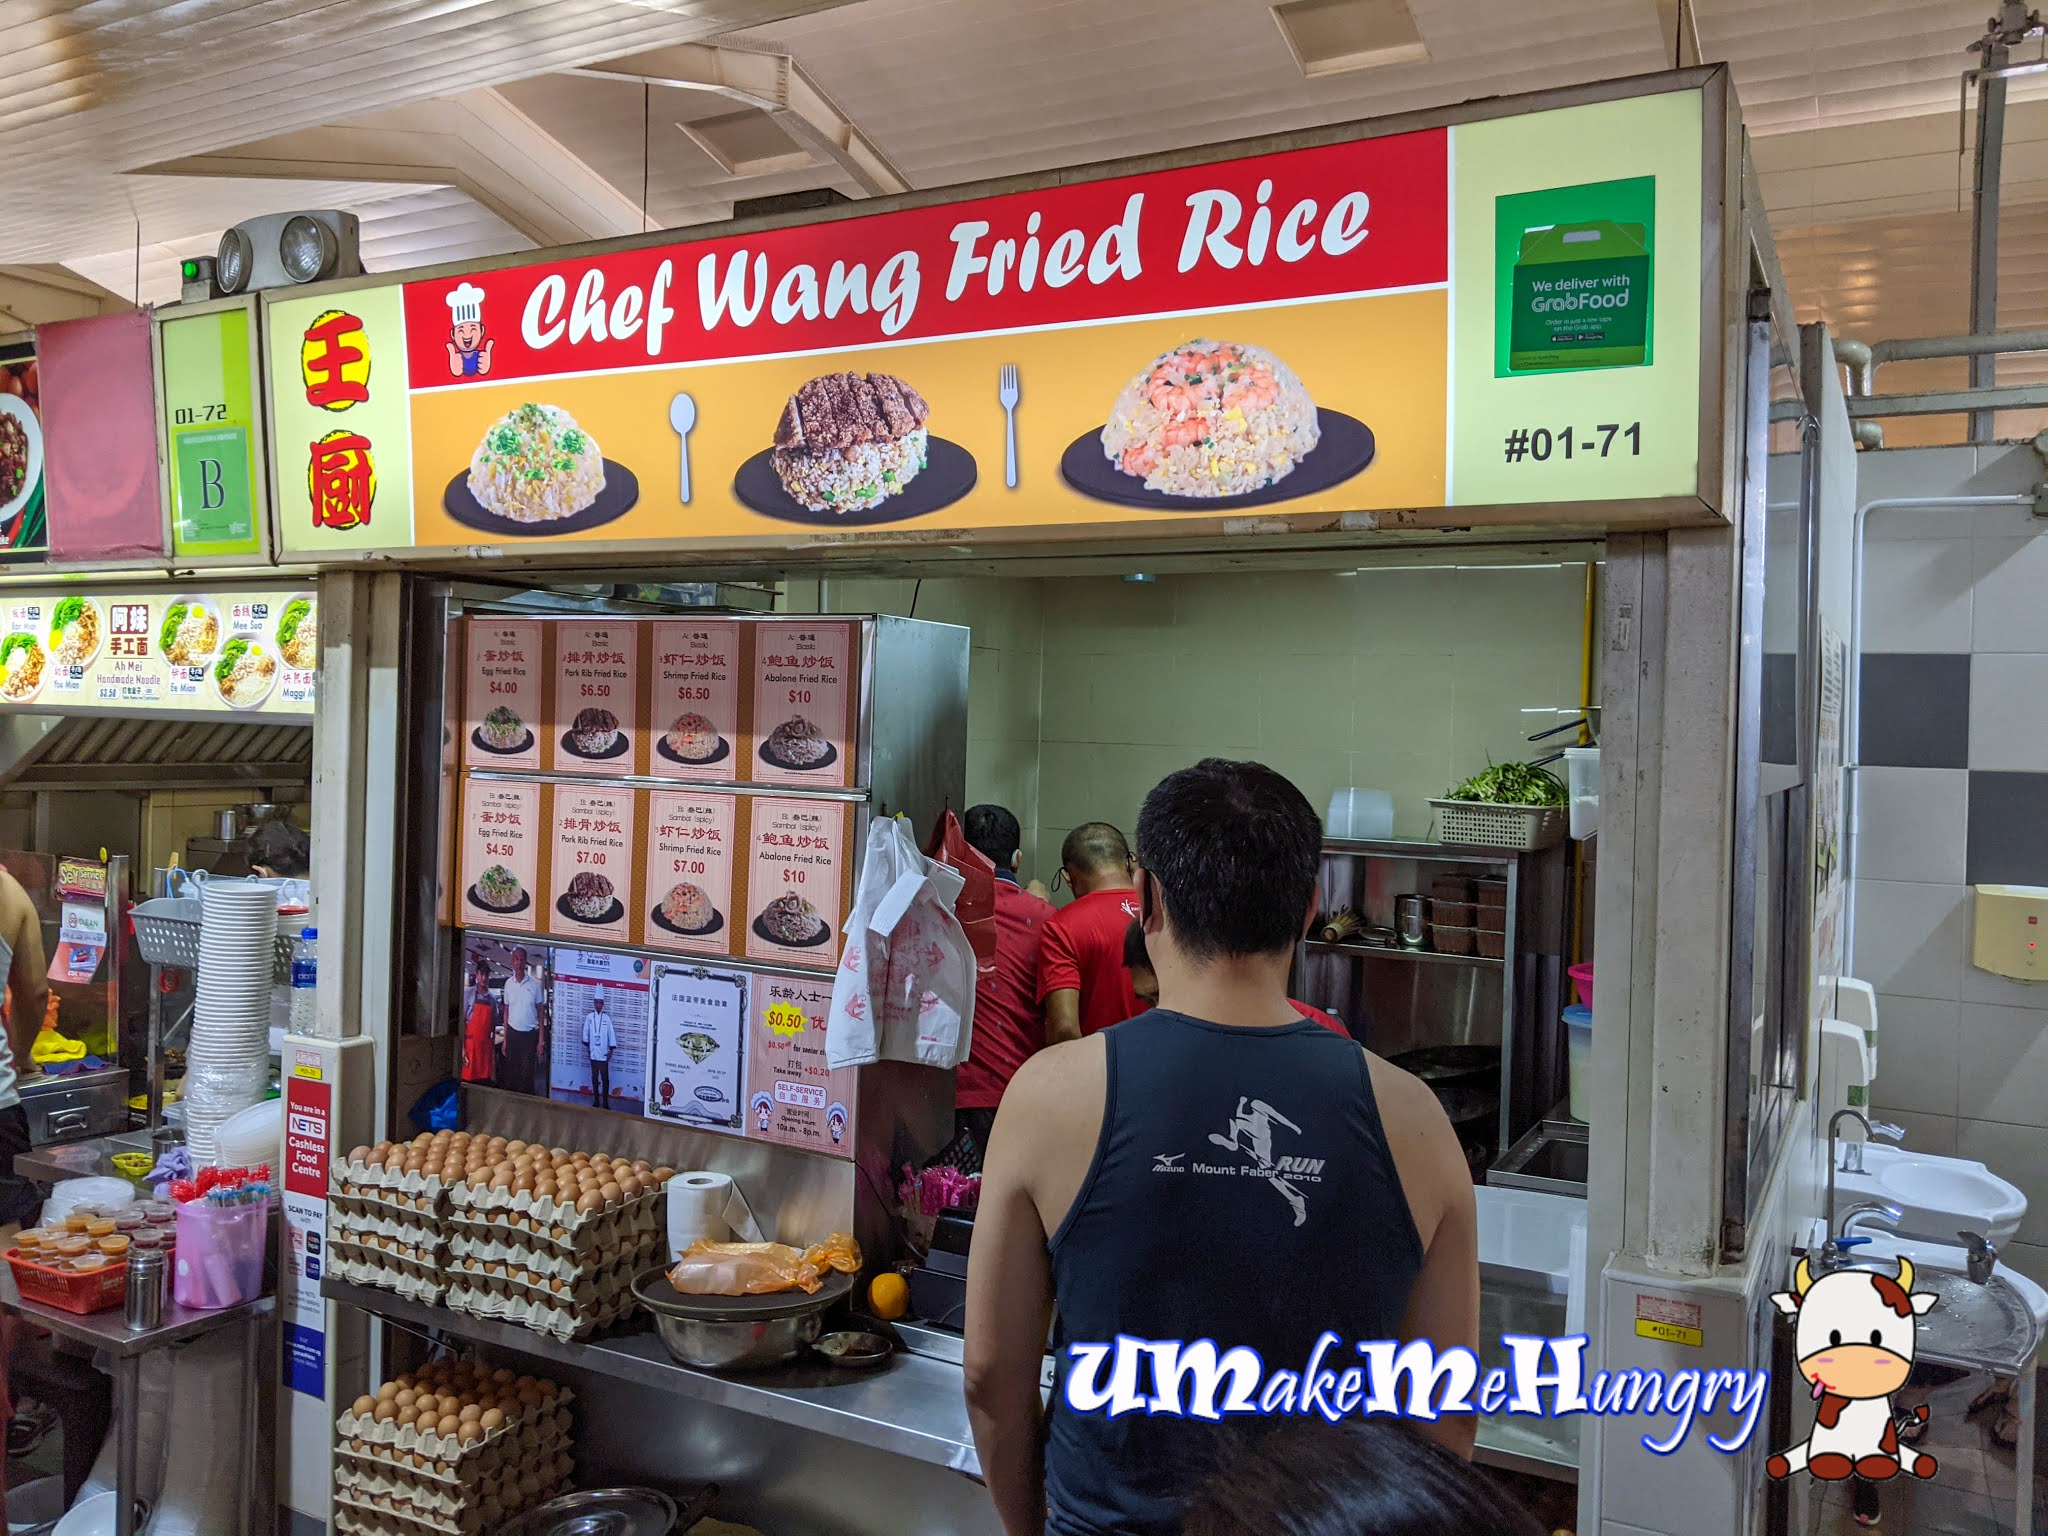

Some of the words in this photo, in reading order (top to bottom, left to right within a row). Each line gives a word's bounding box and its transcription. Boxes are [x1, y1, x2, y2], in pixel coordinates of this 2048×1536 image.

[520, 258, 673, 356] Chef
[695, 248, 922, 336] Wang
[945, 192, 1145, 302] Fried
[1177, 177, 1371, 274] Rice
[1532, 281, 1552, 292] We
[1555, 278, 1599, 291] deliver
[1602, 274, 1630, 287] with
[1531, 288, 1629, 313] GrabFood
[175, 404, 227, 424] 01-72
[1504, 421, 1641, 463] #01-71
[199, 459, 225, 509] B
[233, 620, 247, 629] Mee
[250, 620, 262, 629] Sua
[111, 637, 148, 655] 手工面
[484, 650, 525, 662] 蛋炒饭
[567, 651, 626, 665] 排骨炒饭
[663, 653, 726, 667] 虾仁炒饭
[766, 654, 835, 669] 鲍鱼炒饭
[115, 661, 126, 671] Ah
[128, 661, 143, 671] Mei
[481, 667, 494, 677] Egg
[496, 667, 512, 676] Fried
[513, 668, 526, 676] Rice
[564, 668, 580, 677] Pork
[581, 668, 592, 677] Rib
[594, 669, 611, 678] Fried
[613, 670, 627, 679] Rice
[97, 674, 134, 684] Handmade
[136, 675, 161, 685] Noodle
[663, 671, 689, 681] Shrimp
[690, 671, 709, 681] Fried
[711, 671, 726, 681] Rice
[764, 673, 796, 683] Abalone
[799, 674, 819, 684] Fried
[821, 675, 837, 684] Rice
[54, 680, 63, 688] You
[65, 680, 79, 689] Mian
[171, 683, 178, 692] Ee
[180, 683, 196, 692] Mian
[490, 681, 517, 694] $4.00
[581, 684, 610, 697] $6.50
[282, 688, 306, 700] Maggi
[678, 687, 710, 700] $6.50
[789, 690, 811, 703] $10
[480, 811, 522, 826] 蛋炒饭
[563, 817, 622, 834] 排骨炒饭
[478, 828, 490, 838] Egg
[492, 829, 508, 838] Fried
[509, 830, 523, 839] Rice
[659, 824, 722, 842] 虾仁炒饭
[561, 835, 576, 844] Pork
[578, 836, 589, 845] Rib
[590, 837, 607, 847] Fried
[609, 838, 623, 848] Rice
[761, 832, 830, 850] 鲍鱼炒饭
[486, 842, 514, 857] $4.50
[659, 842, 685, 853] Shrimp
[686, 845, 704, 855] Fried
[706, 846, 722, 856] Rice
[576, 851, 606, 865] $7.00
[759, 851, 791, 862] Abalone
[793, 853, 813, 864] Fried
[815, 854, 832, 866] Rice
[673, 859, 705, 874] $7.00
[60, 864, 79, 885] Self
[80, 867, 104, 881] Service
[783, 869, 805, 884] $10
[79, 917, 99, 928] CLEAN
[768, 1010, 802, 1029] $0.50
[768, 1040, 785, 1050] $0.50
[793, 1043, 801, 1052] for
[802, 1046, 819, 1055] senior
[773, 1066, 786, 1075] Take
[787, 1070, 802, 1078] away
[803, 1066, 830, 1077] +$0.20
[787, 1060, 802, 1070] 打包
[777, 1083, 824, 1097] SELF-SERVICE
[779, 1091, 821, 1106] 自助服务
[290, 1101, 303, 1112] You
[303, 1105, 314, 1114] are
[314, 1105, 321, 1114] in
[321, 1108, 326, 1116] a
[292, 1117, 323, 1135] NETS
[781, 1115, 801, 1124] Opening
[776, 1123, 797, 1133] 10a.m.
[802, 1127, 821, 1137] 8p.m.
[288, 1136, 325, 1154] Cashless
[296, 1150, 318, 1165] Food
[1274, 1155, 1326, 1175] RUN
[291, 1162, 321, 1178] Centre
[1192, 1162, 1236, 1176] Mount
[1240, 1165, 1279, 1178] Faber
[1283, 1173, 1322, 1183] 2010
[288, 1205, 304, 1215] SCAN
[304, 1208, 312, 1217] TO
[313, 1211, 323, 1220] PAY
[1651, 1325, 1687, 1340] #01-71
